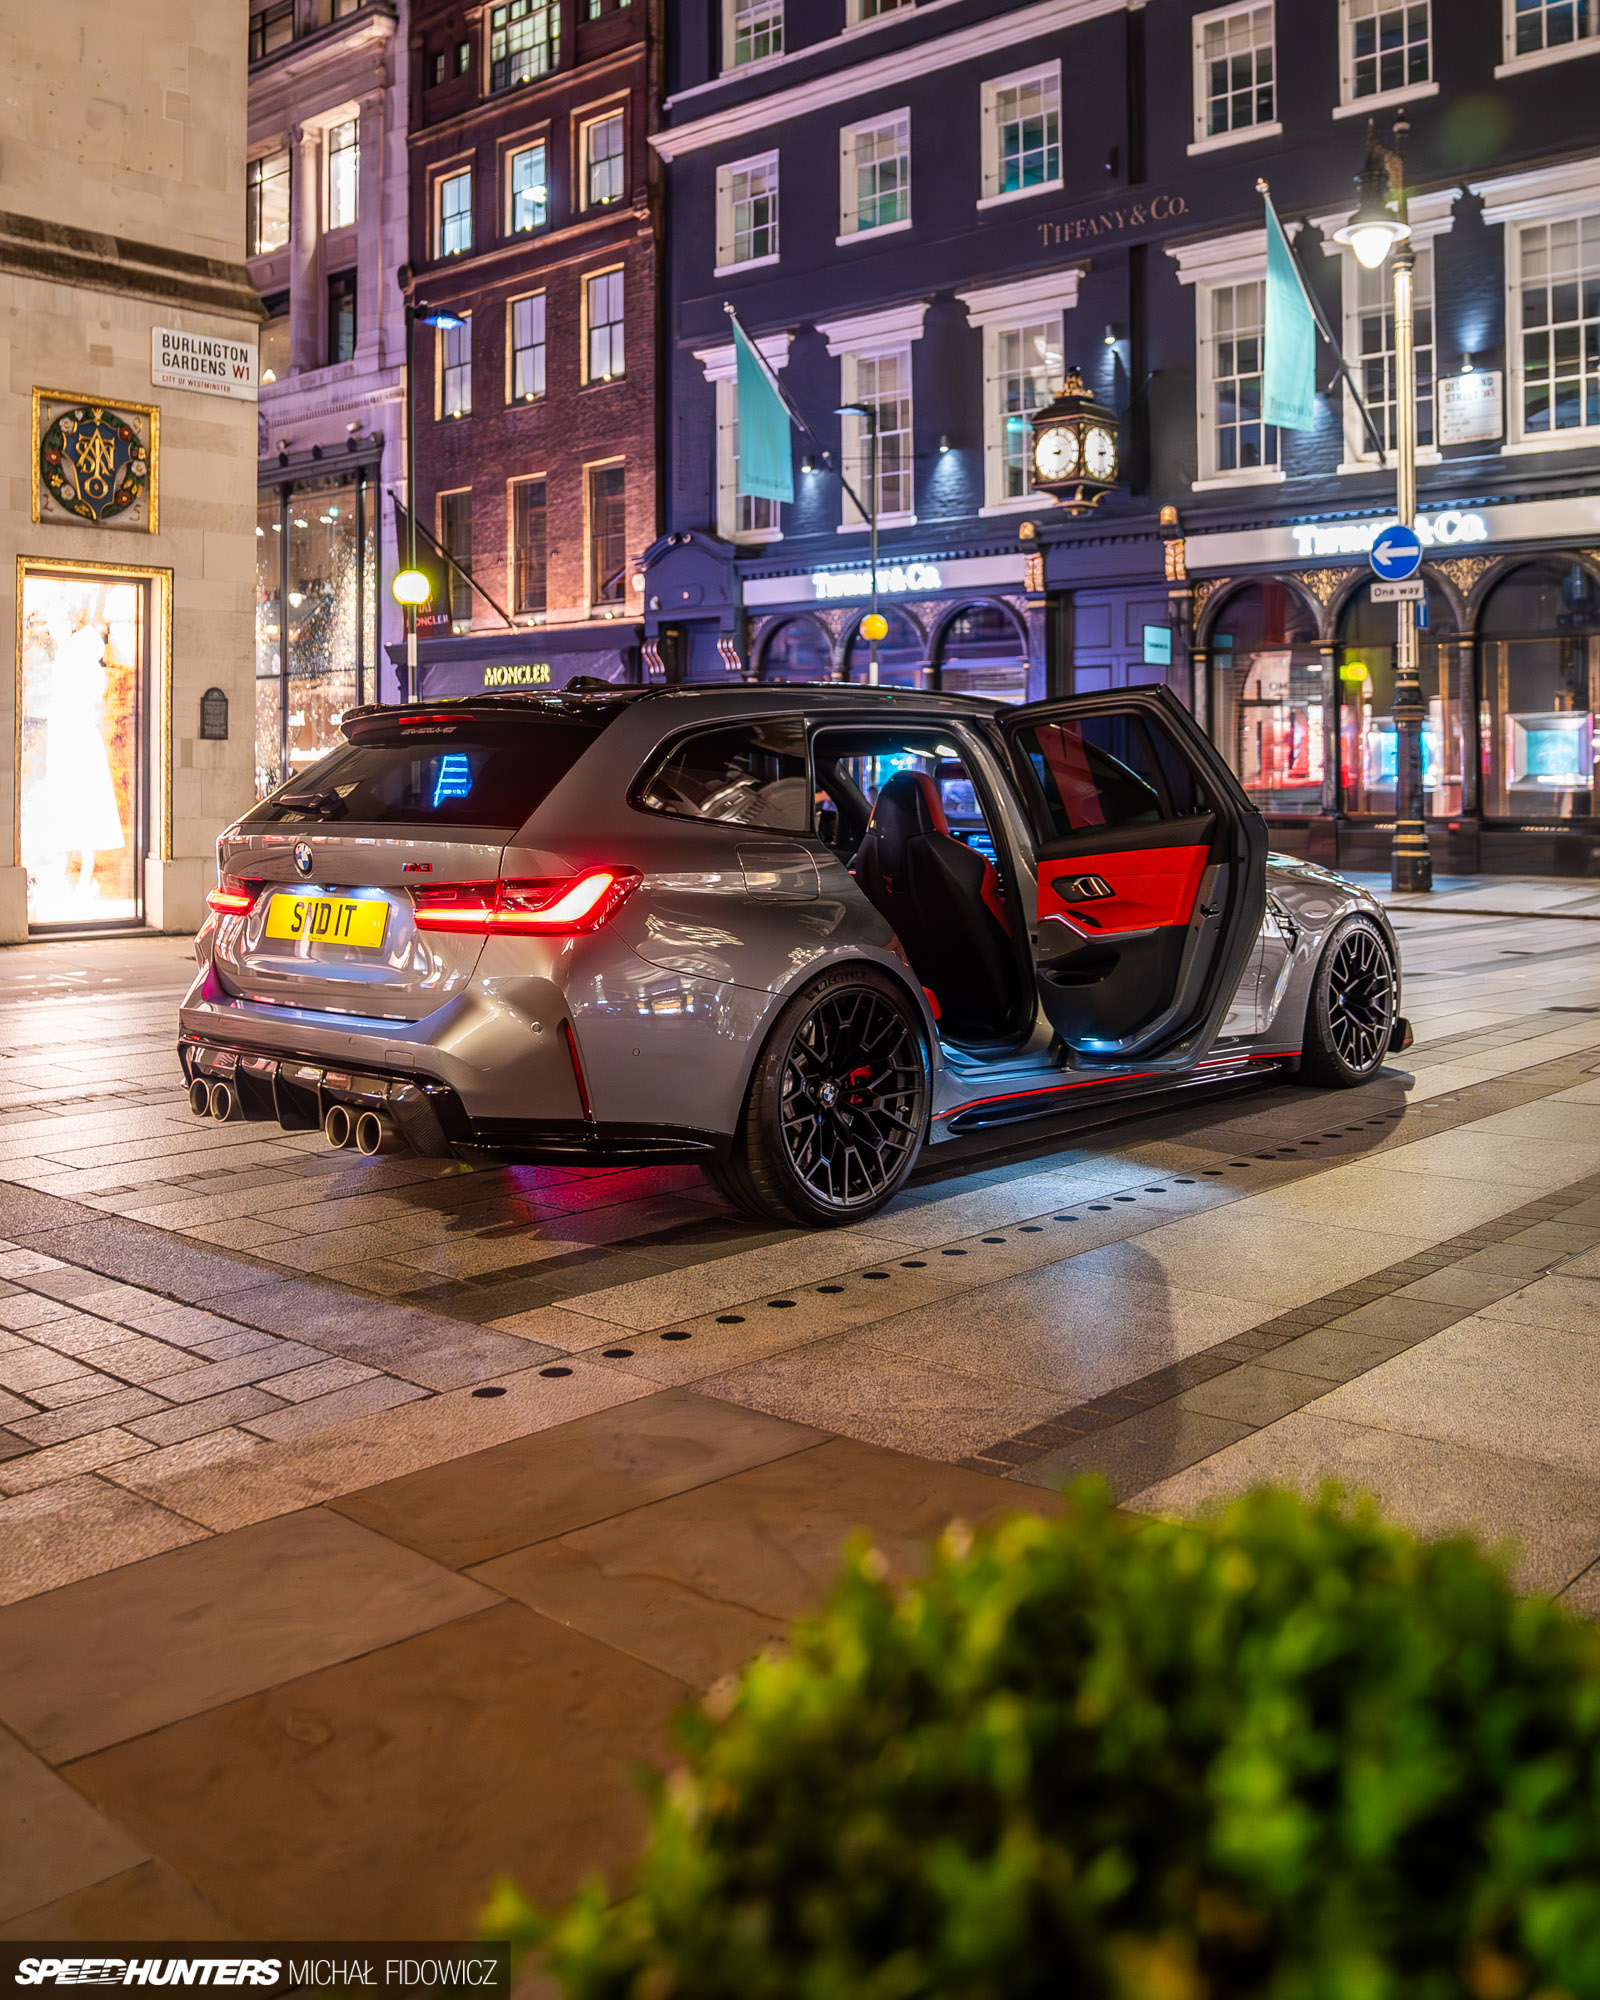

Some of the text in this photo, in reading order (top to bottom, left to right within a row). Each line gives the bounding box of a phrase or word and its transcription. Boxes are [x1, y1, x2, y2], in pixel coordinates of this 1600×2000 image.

[162, 334, 248, 363] BURLINGTON
[162, 352, 250, 381] GARDENS W1
[162, 375, 175, 383] CITY
[188, 380, 231, 393] WESTMINSTER
[1374, 586, 1419, 597] One way
[484, 663, 551, 686] MONCLER
[408, 862, 430, 873] M3
